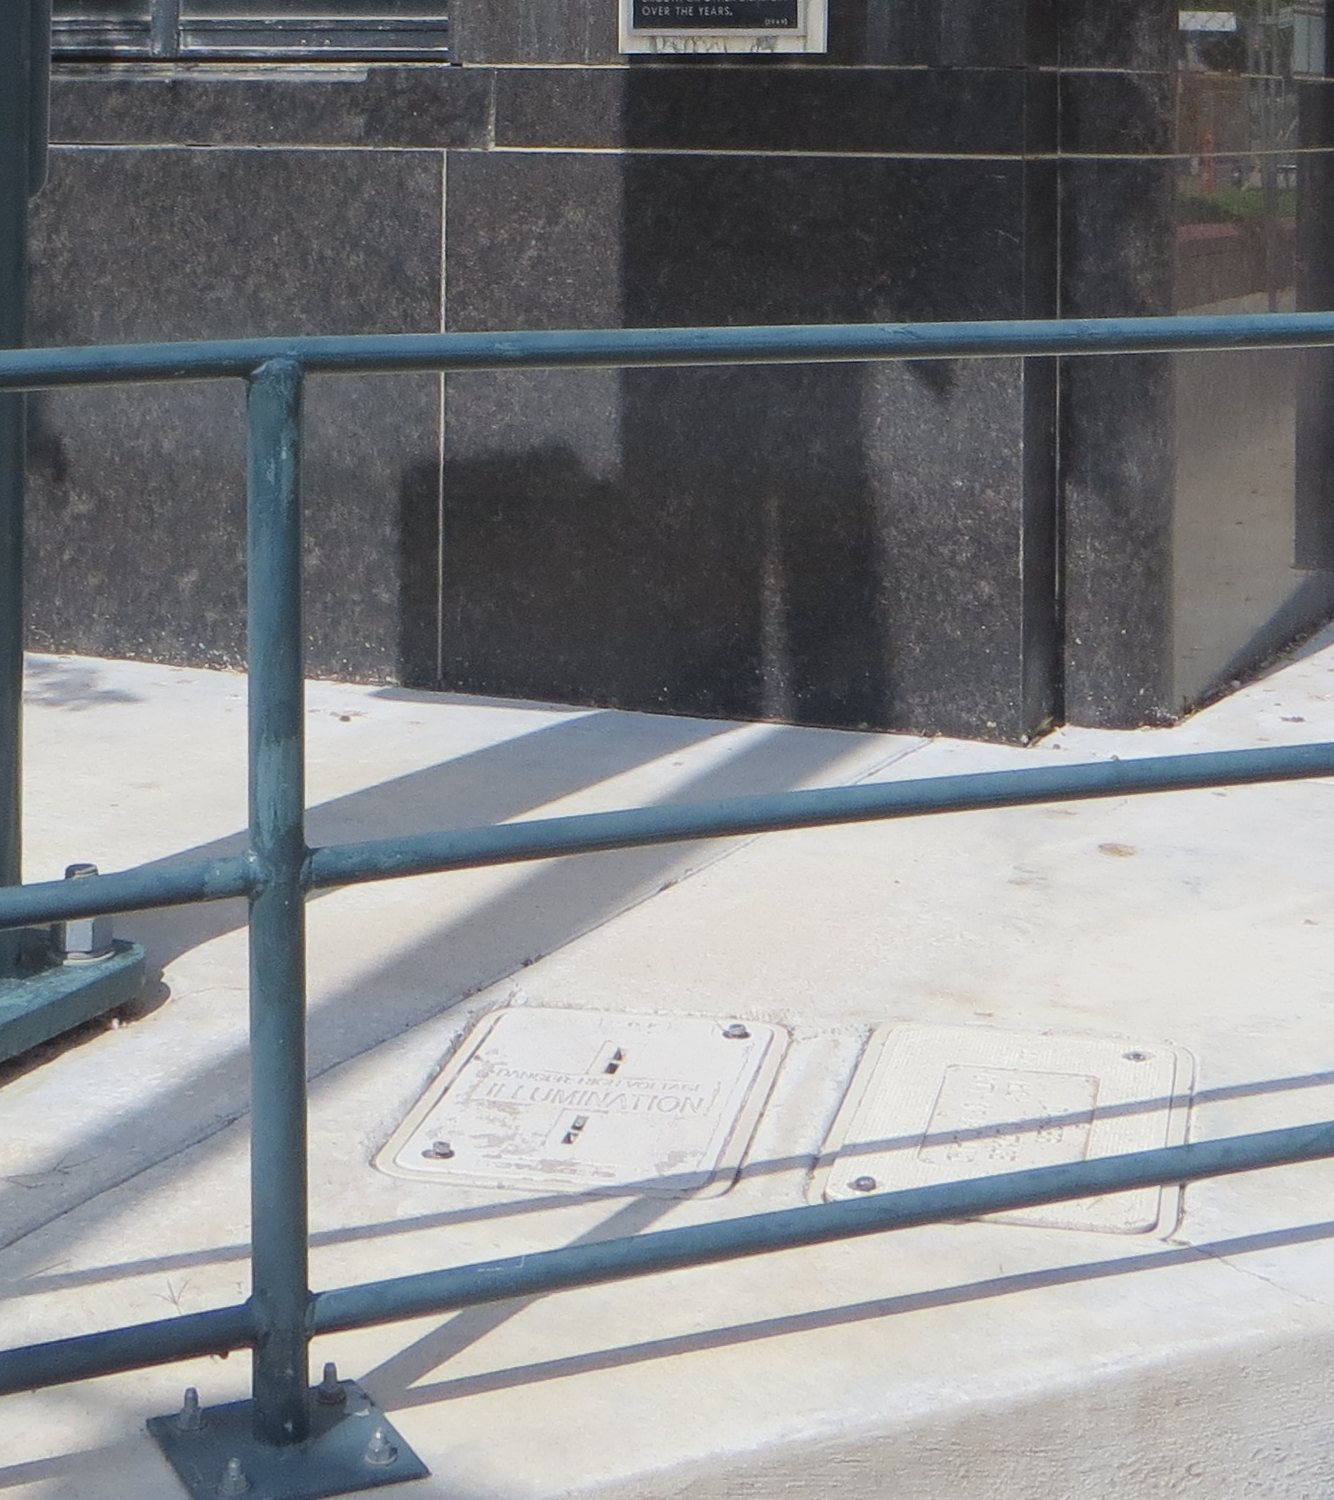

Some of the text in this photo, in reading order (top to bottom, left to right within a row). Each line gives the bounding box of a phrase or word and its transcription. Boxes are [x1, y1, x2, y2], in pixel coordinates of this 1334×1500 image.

[642, 6, 733, 16] OVER THE YEARS.
[493, 1067, 570, 1084] DANGER
[484, 1082, 705, 1115] ILLUMINATION
